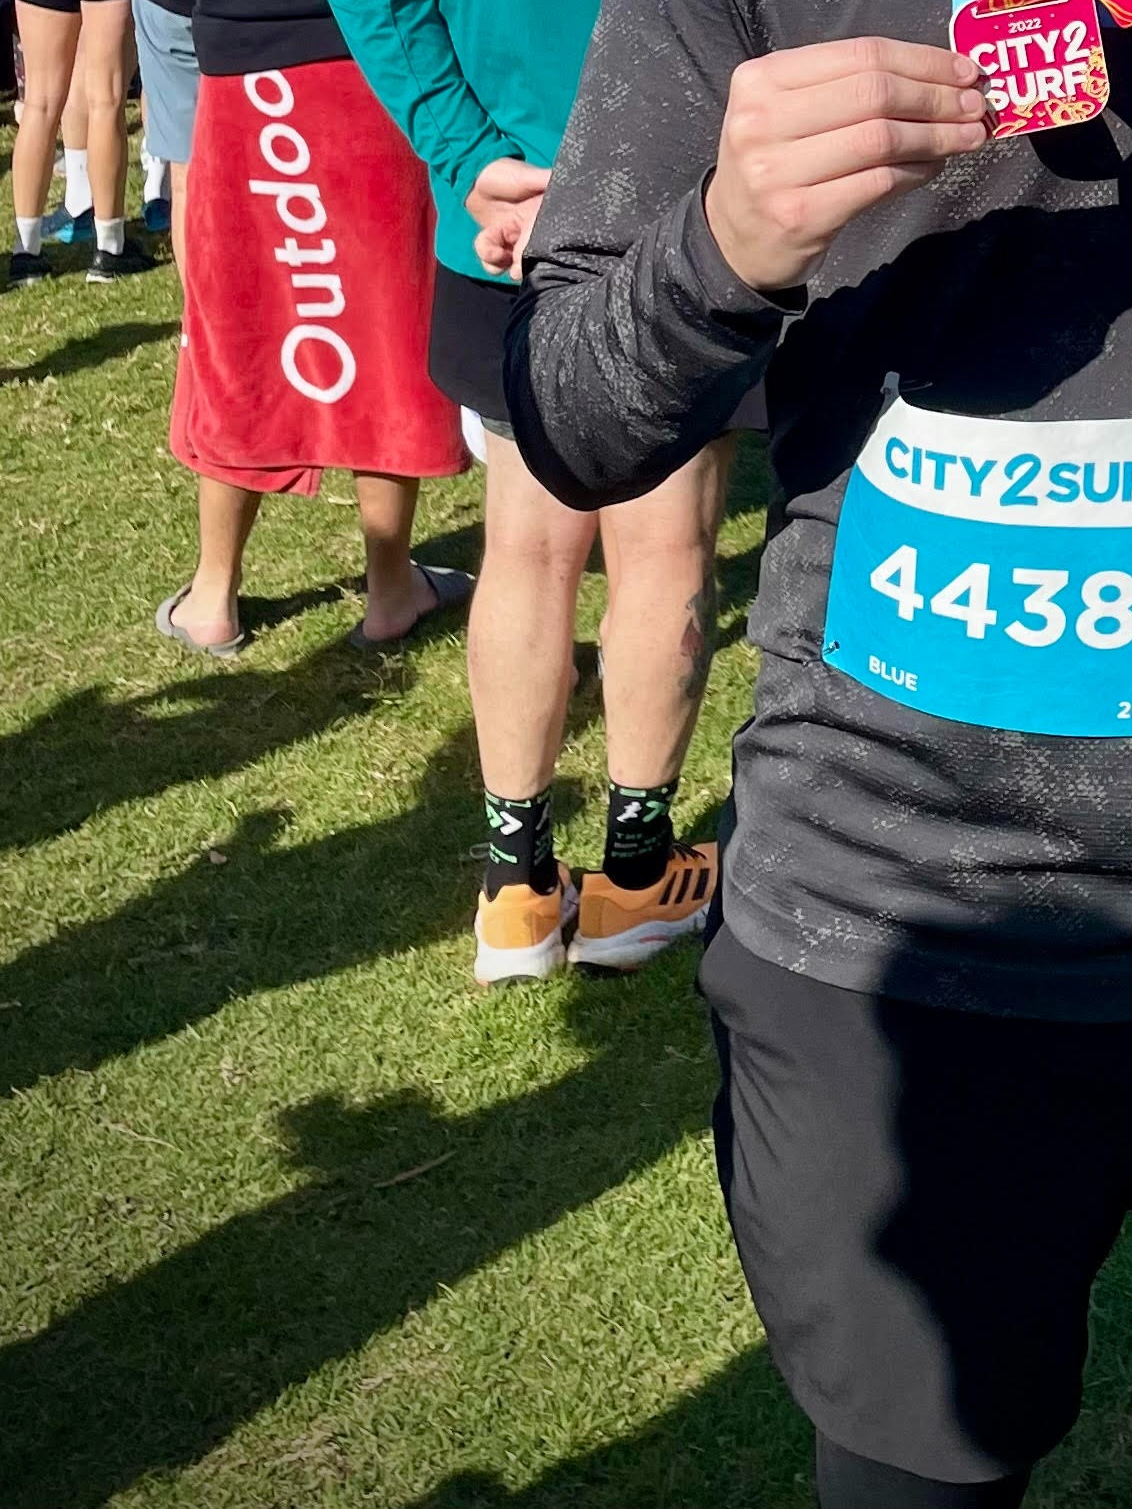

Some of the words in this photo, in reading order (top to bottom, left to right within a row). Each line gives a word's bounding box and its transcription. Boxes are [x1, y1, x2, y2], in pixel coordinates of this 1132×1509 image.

[969, 20, 1091, 76] CITY2
[1008, 18, 1042, 34] 2022
[985, 61, 1088, 112] SURF
[868, 655, 919, 693] BLUE
